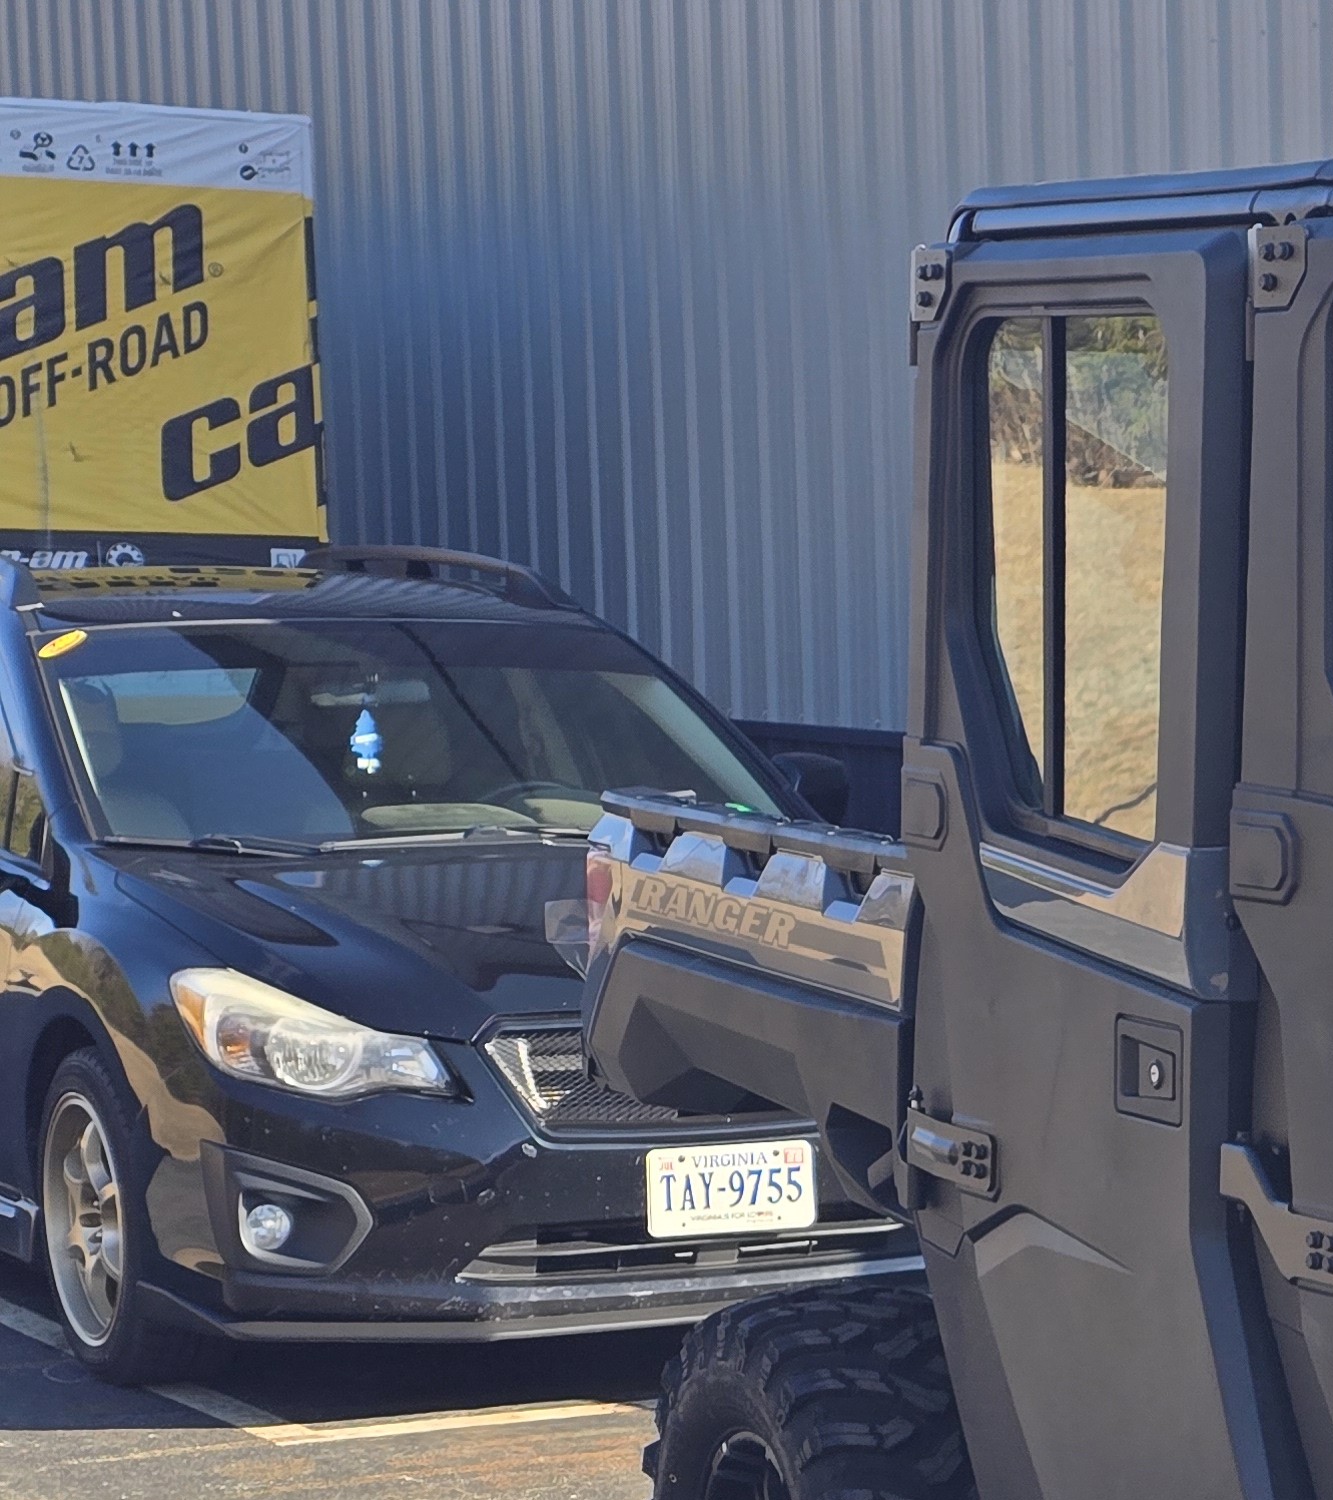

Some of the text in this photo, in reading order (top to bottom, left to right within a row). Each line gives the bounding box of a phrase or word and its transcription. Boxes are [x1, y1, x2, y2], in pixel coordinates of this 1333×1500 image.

[161, 364, 320, 501] ca
[638, 876, 796, 949] RANGER
[659, 1167, 803, 1211] TAY-9755
[692, 1151, 768, 1169] VIRGINIA
